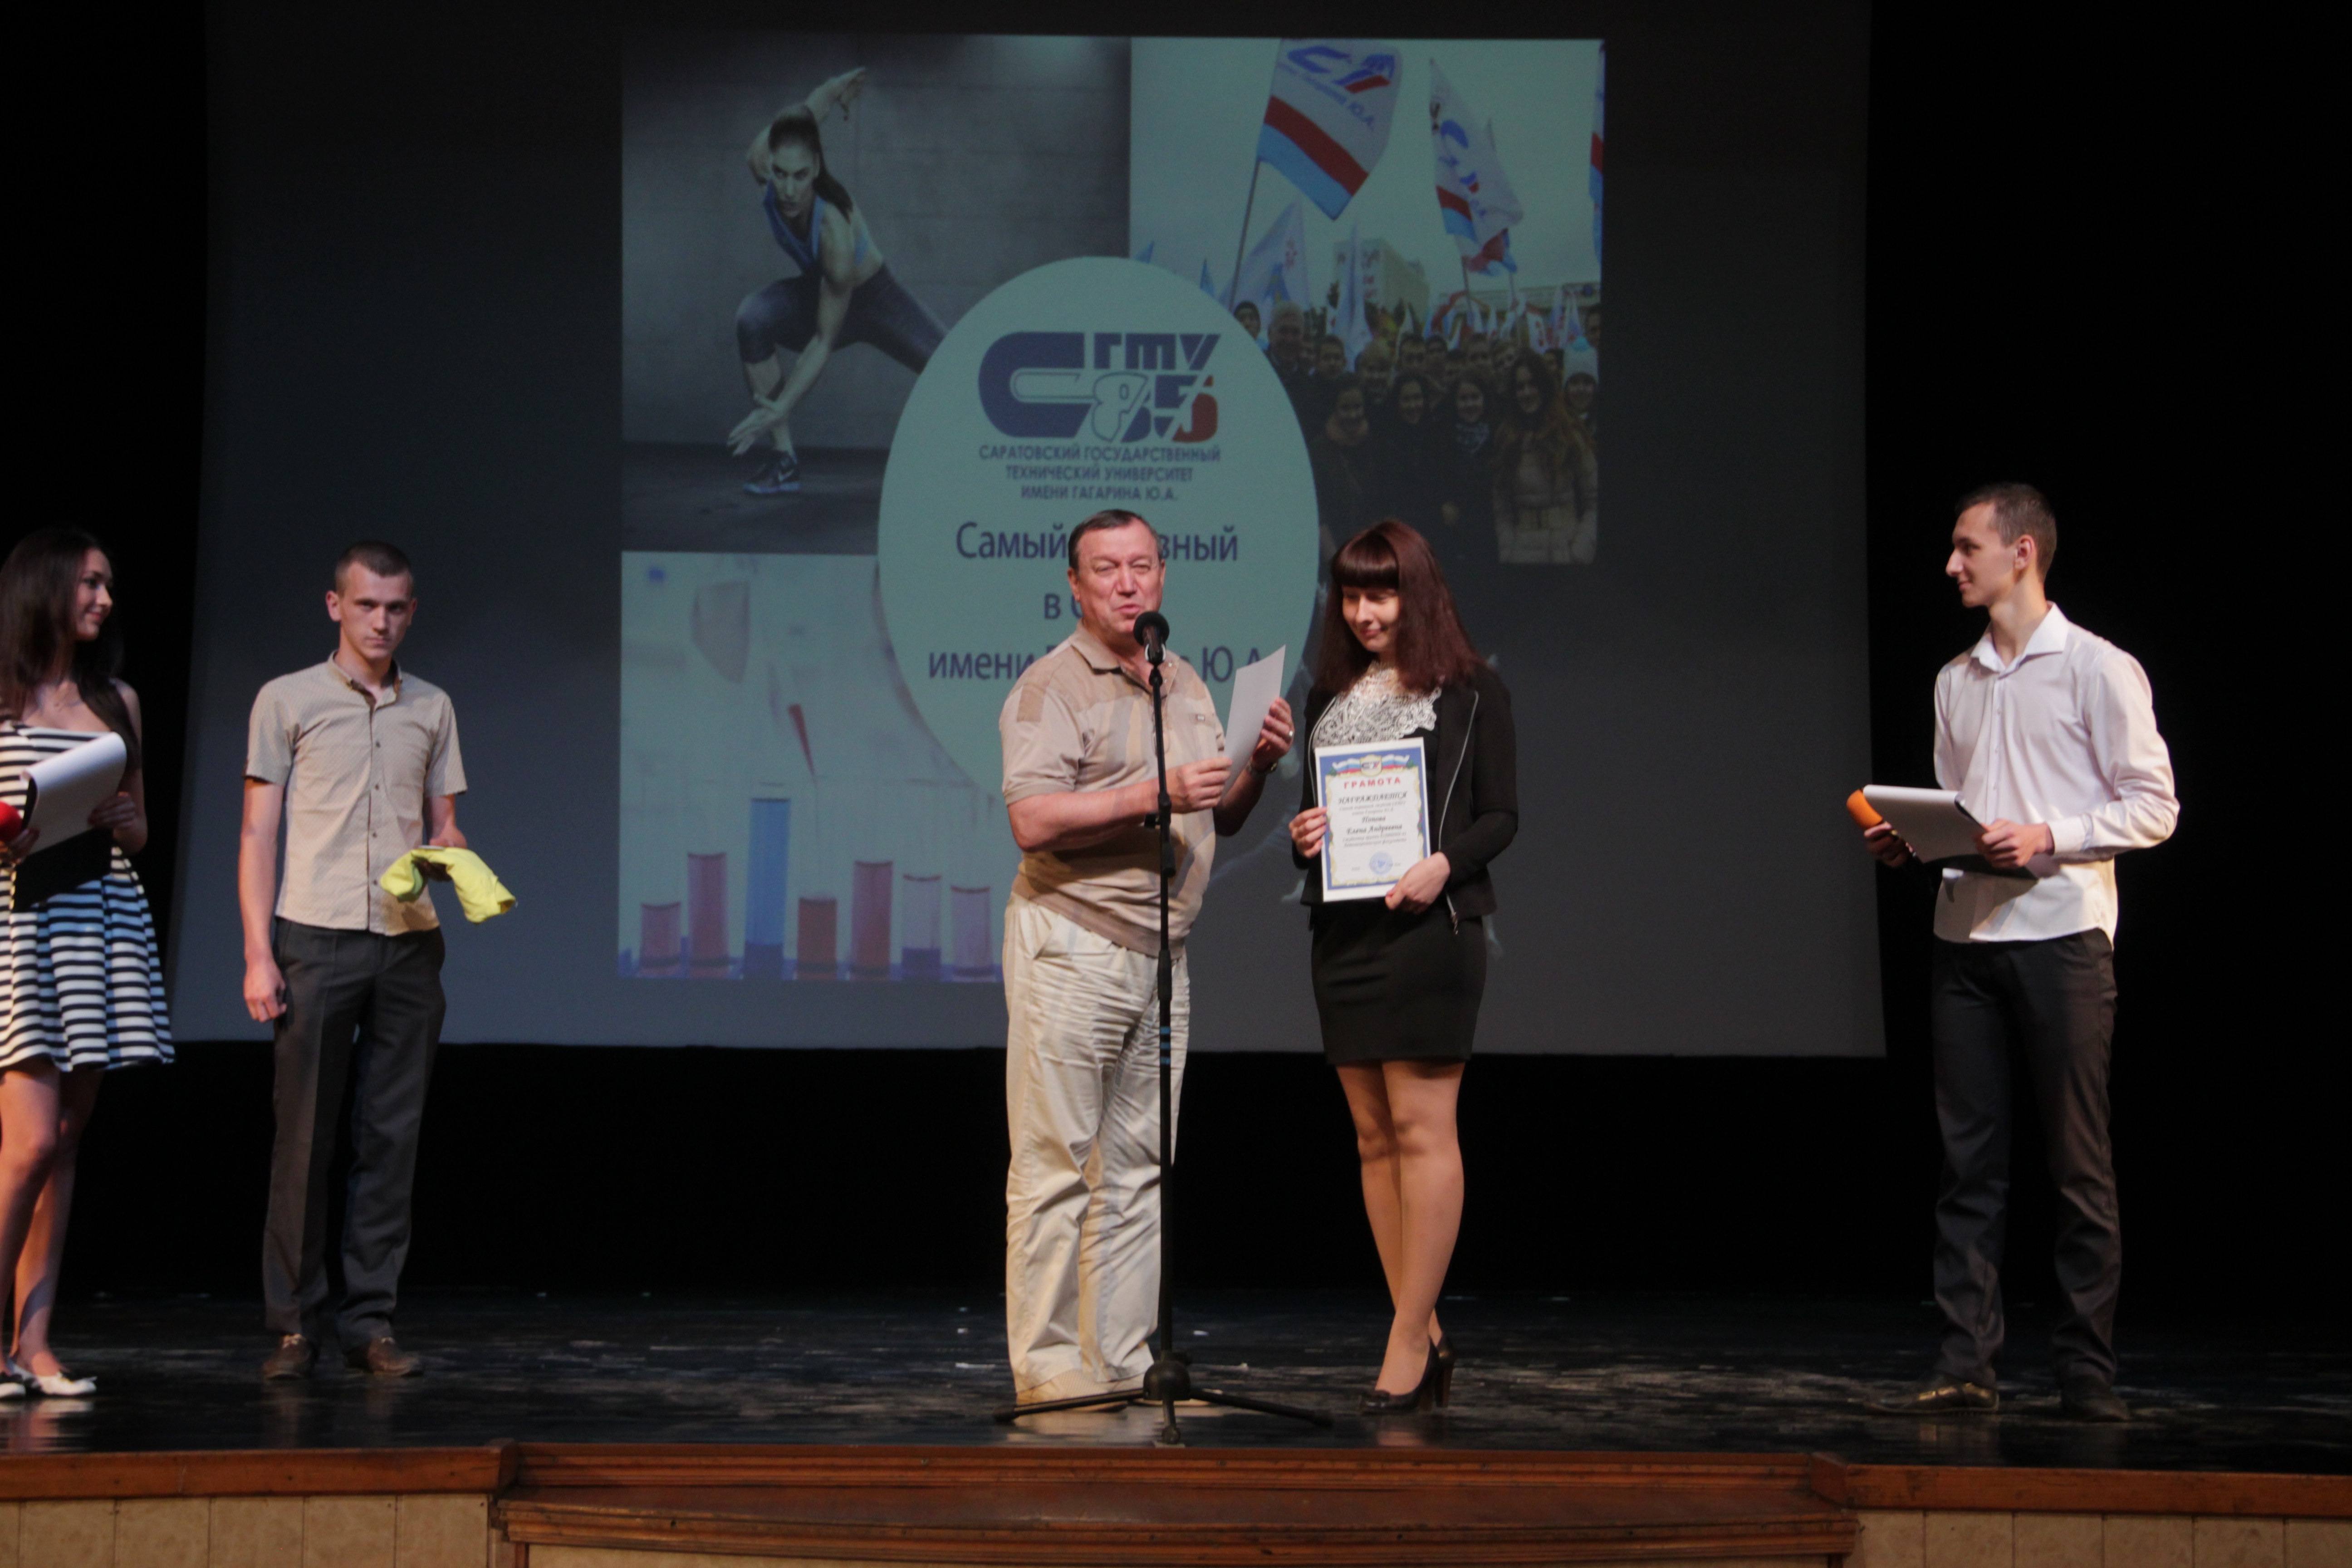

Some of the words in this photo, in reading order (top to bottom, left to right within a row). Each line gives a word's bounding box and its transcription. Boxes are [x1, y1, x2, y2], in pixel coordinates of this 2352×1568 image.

[979, 443, 1080, 461] САРАТОВСКИЙ
[1084, 445, 1221, 462] ГОСУДАРСТВЕННЫЙ
[1006, 463, 1100, 480] ТЕХНИЧЕСКИЙ
[1104, 467, 1193, 482] УНИВЕРСИТЕТ
[1022, 485, 1068, 498] ИМЕНИ
[1072, 486, 1141, 499] ГАГАРИНА
[957, 521, 1066, 559] Самый
[1158, 524, 1237, 561] вный
[1044, 593, 1061, 620] в
[929, 652, 1034, 680] имени
[1344, 776, 1401, 789] ГРАМОТА
[1338, 791, 1408, 805] НАГРАЖДАЕТСЯ
